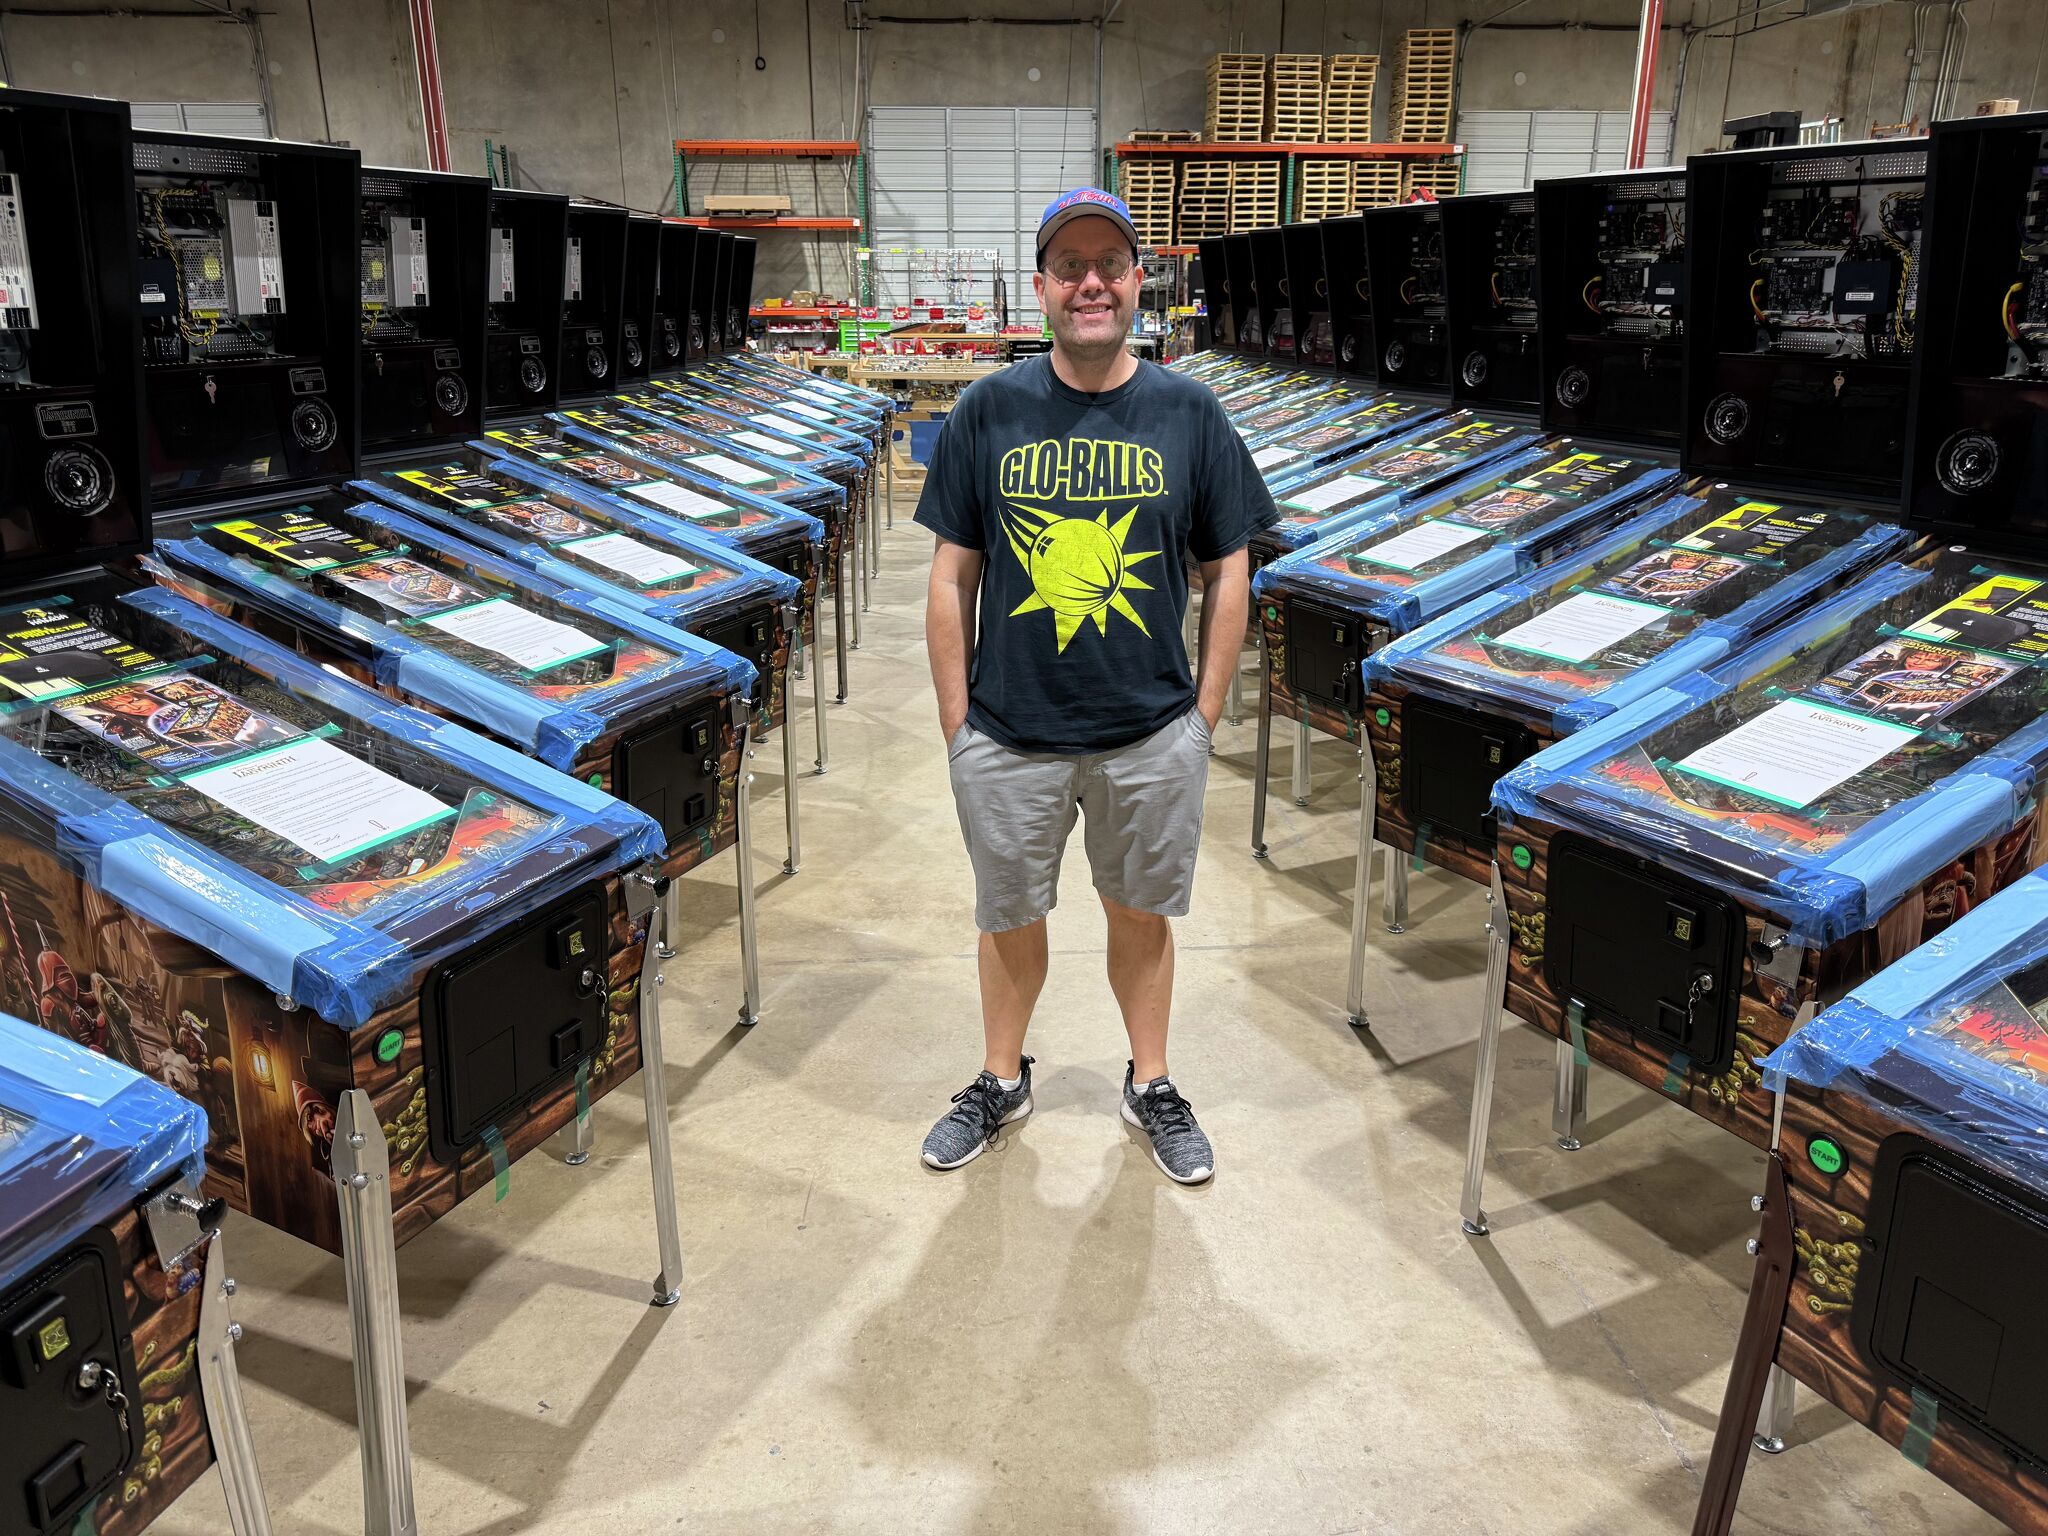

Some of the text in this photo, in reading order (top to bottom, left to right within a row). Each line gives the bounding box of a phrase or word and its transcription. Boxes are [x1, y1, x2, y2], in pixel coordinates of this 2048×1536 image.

[1000, 437, 1163, 501] GLO-BALLS
[1807, 711, 1868, 734] LABYRINTH
[379, 1038, 401, 1055] START
[1810, 1146, 1839, 1166] START
